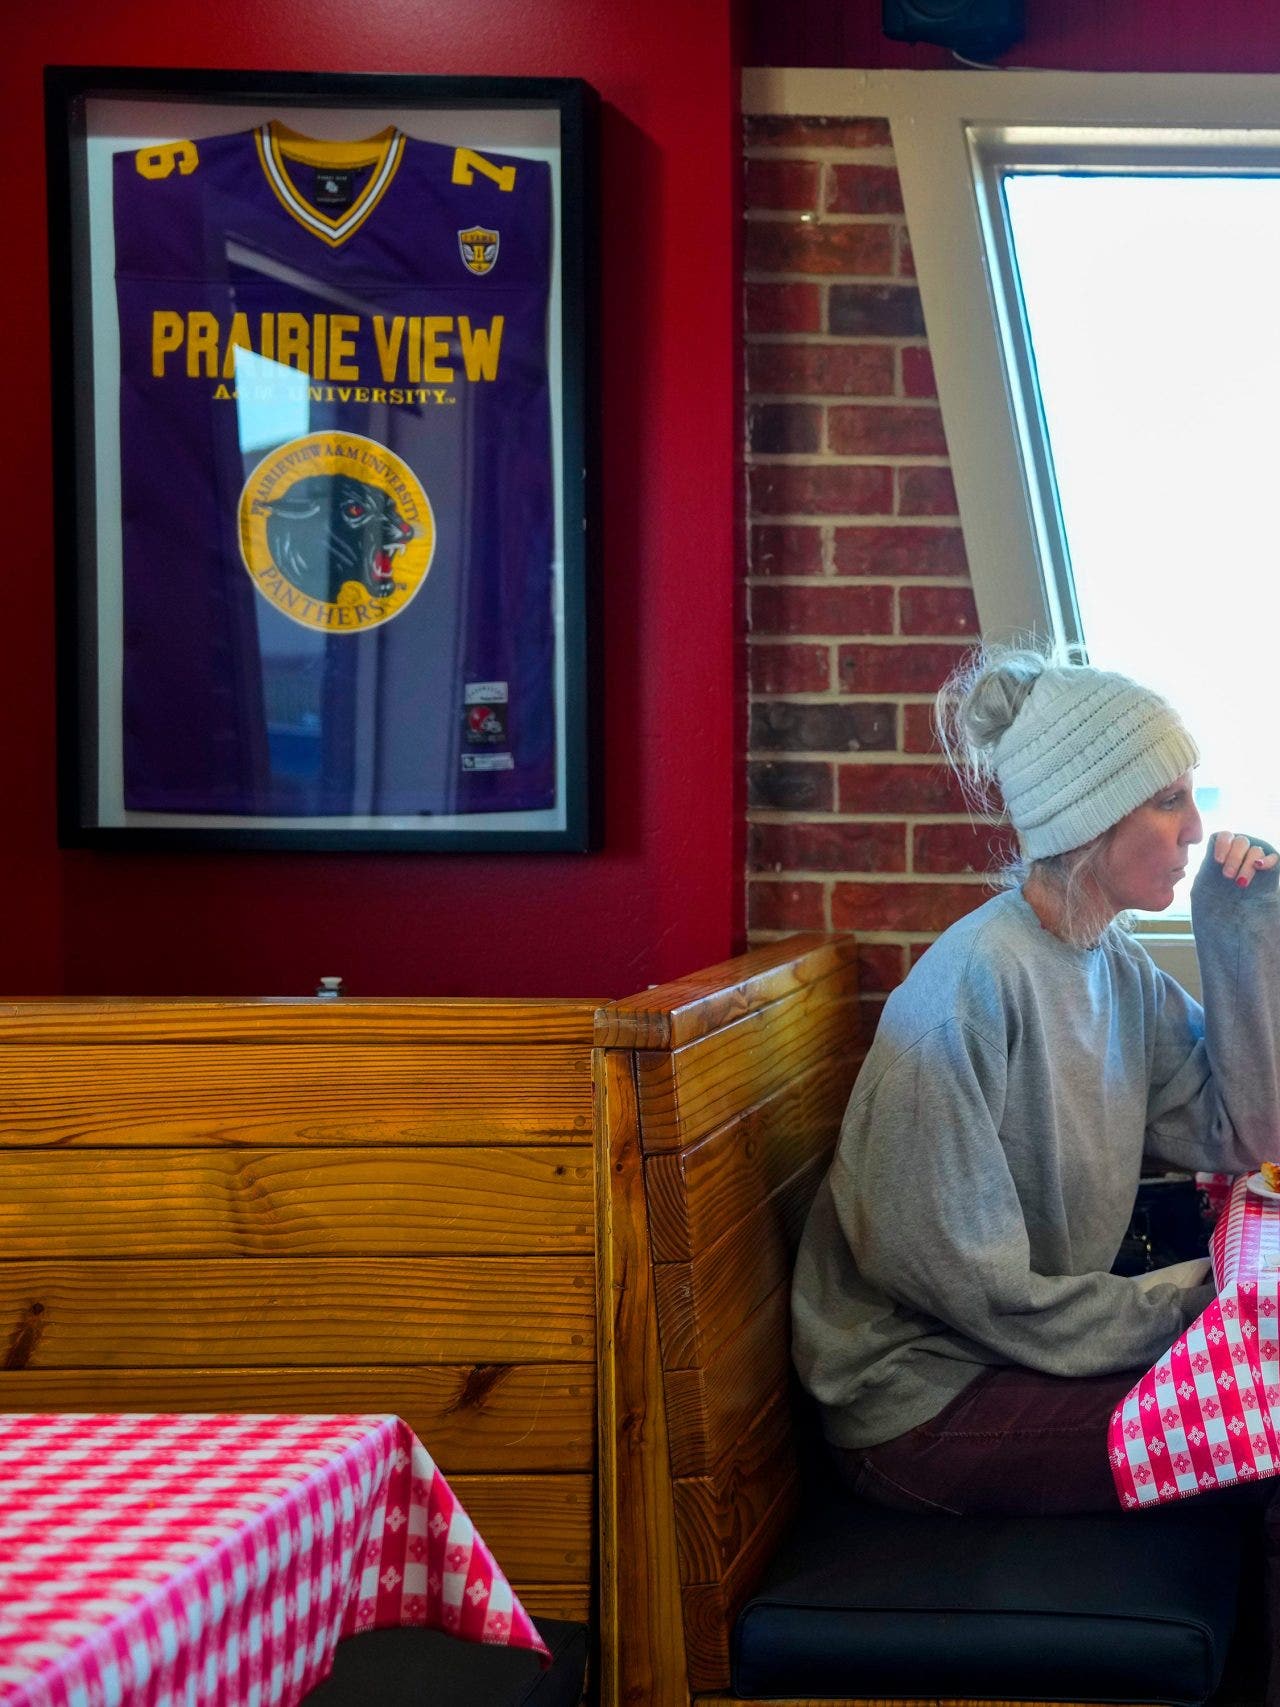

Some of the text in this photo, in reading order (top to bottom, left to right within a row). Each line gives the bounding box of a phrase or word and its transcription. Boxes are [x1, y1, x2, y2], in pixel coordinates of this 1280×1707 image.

[152, 311, 504, 383] PRAIRIE VIEW
[259, 567, 387, 626] PANTHERS
